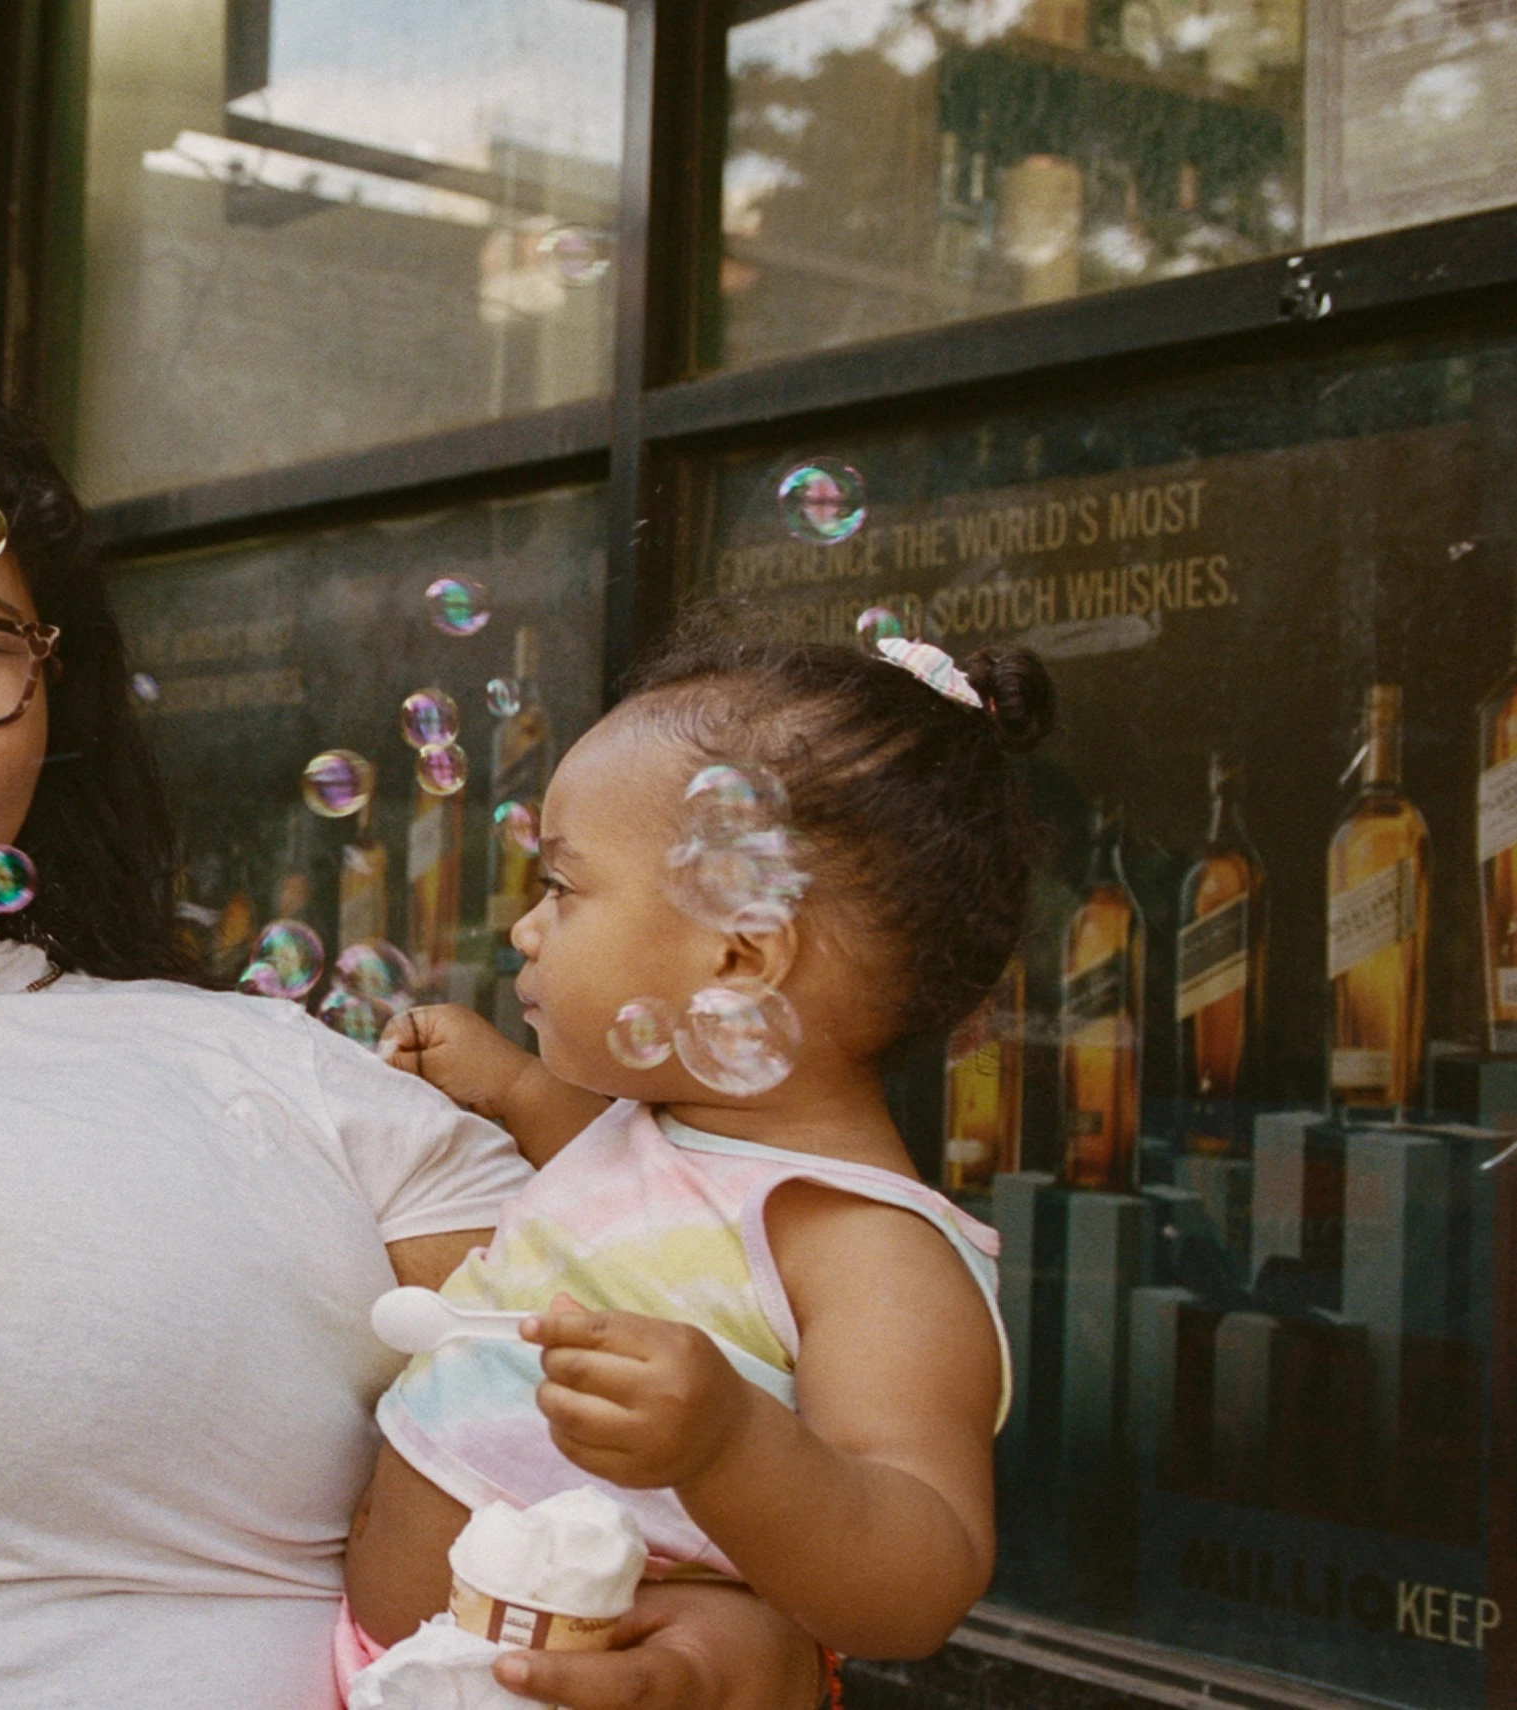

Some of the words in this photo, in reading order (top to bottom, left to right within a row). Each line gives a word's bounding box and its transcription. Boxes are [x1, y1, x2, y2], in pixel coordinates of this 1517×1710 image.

[717, 529, 885, 594] EXPERIENCE
[891, 521, 947, 567] THE
[954, 496, 1101, 557] WORLD'S
[1109, 479, 1208, 541] MOST
[929, 579, 1058, 637] SCOTCH
[1066, 555, 1240, 621] WHISKIES.
[1395, 1579, 1503, 1651] KEEP
